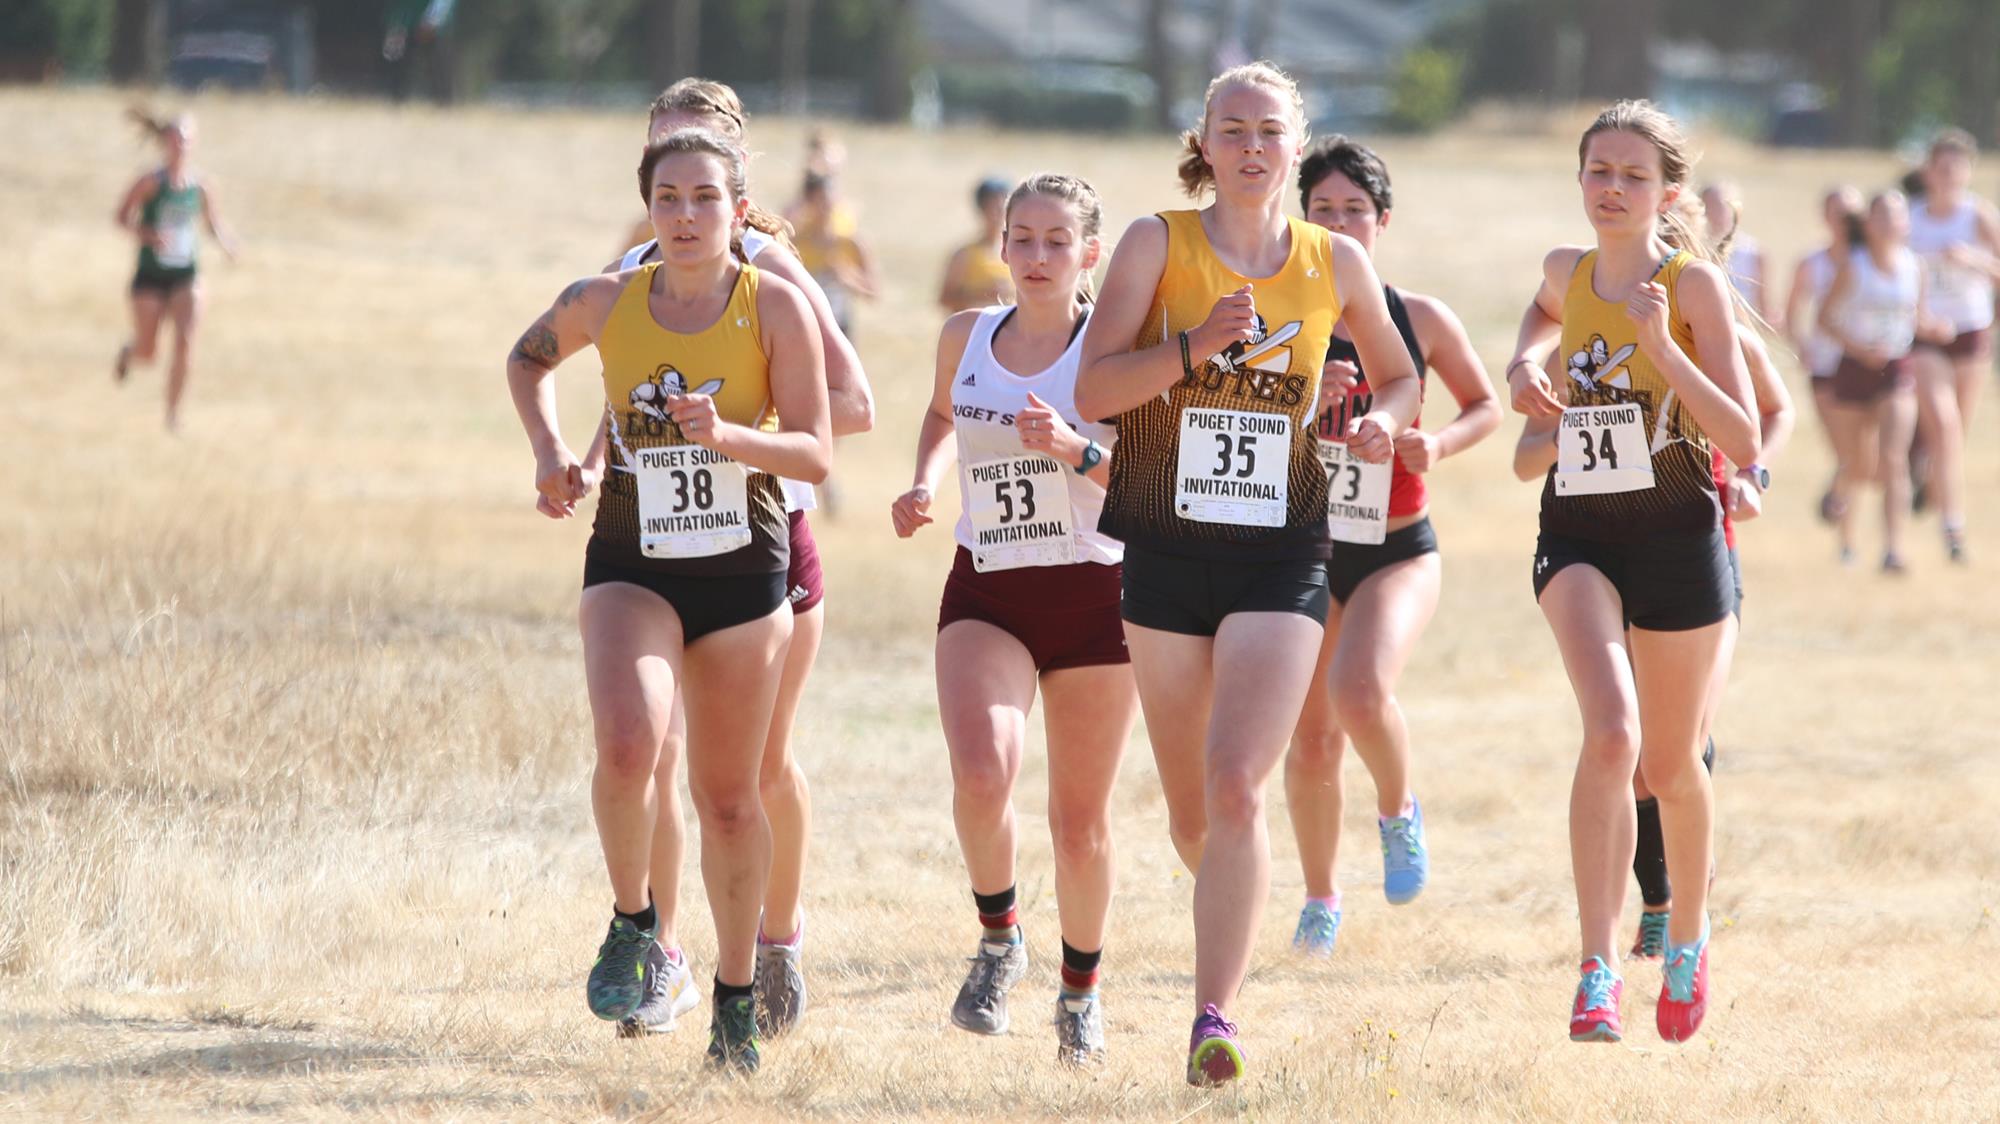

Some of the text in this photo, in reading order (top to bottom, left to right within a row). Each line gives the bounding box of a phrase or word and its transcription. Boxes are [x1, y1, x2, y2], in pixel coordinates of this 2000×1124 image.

[1189, 412, 1285, 435] PUGET SOUND
[1562, 409, 1635, 428] PUGET SOUND
[643, 449, 736, 468] PUGET SOUN
[1212, 433, 1257, 478] 35
[1578, 429, 1618, 471] 34
[972, 459, 1058, 483] PUGET SOUND
[1325, 462, 1361, 501] 73
[670, 469, 713, 513] 38
[1184, 477, 1279, 500] INVITATIONAL
[995, 479, 1036, 524] 53
[1329, 503, 1381, 521] ATIONAL
[647, 511, 741, 533] INVITATIONAL
[979, 521, 1066, 545] INVITATIONAL
